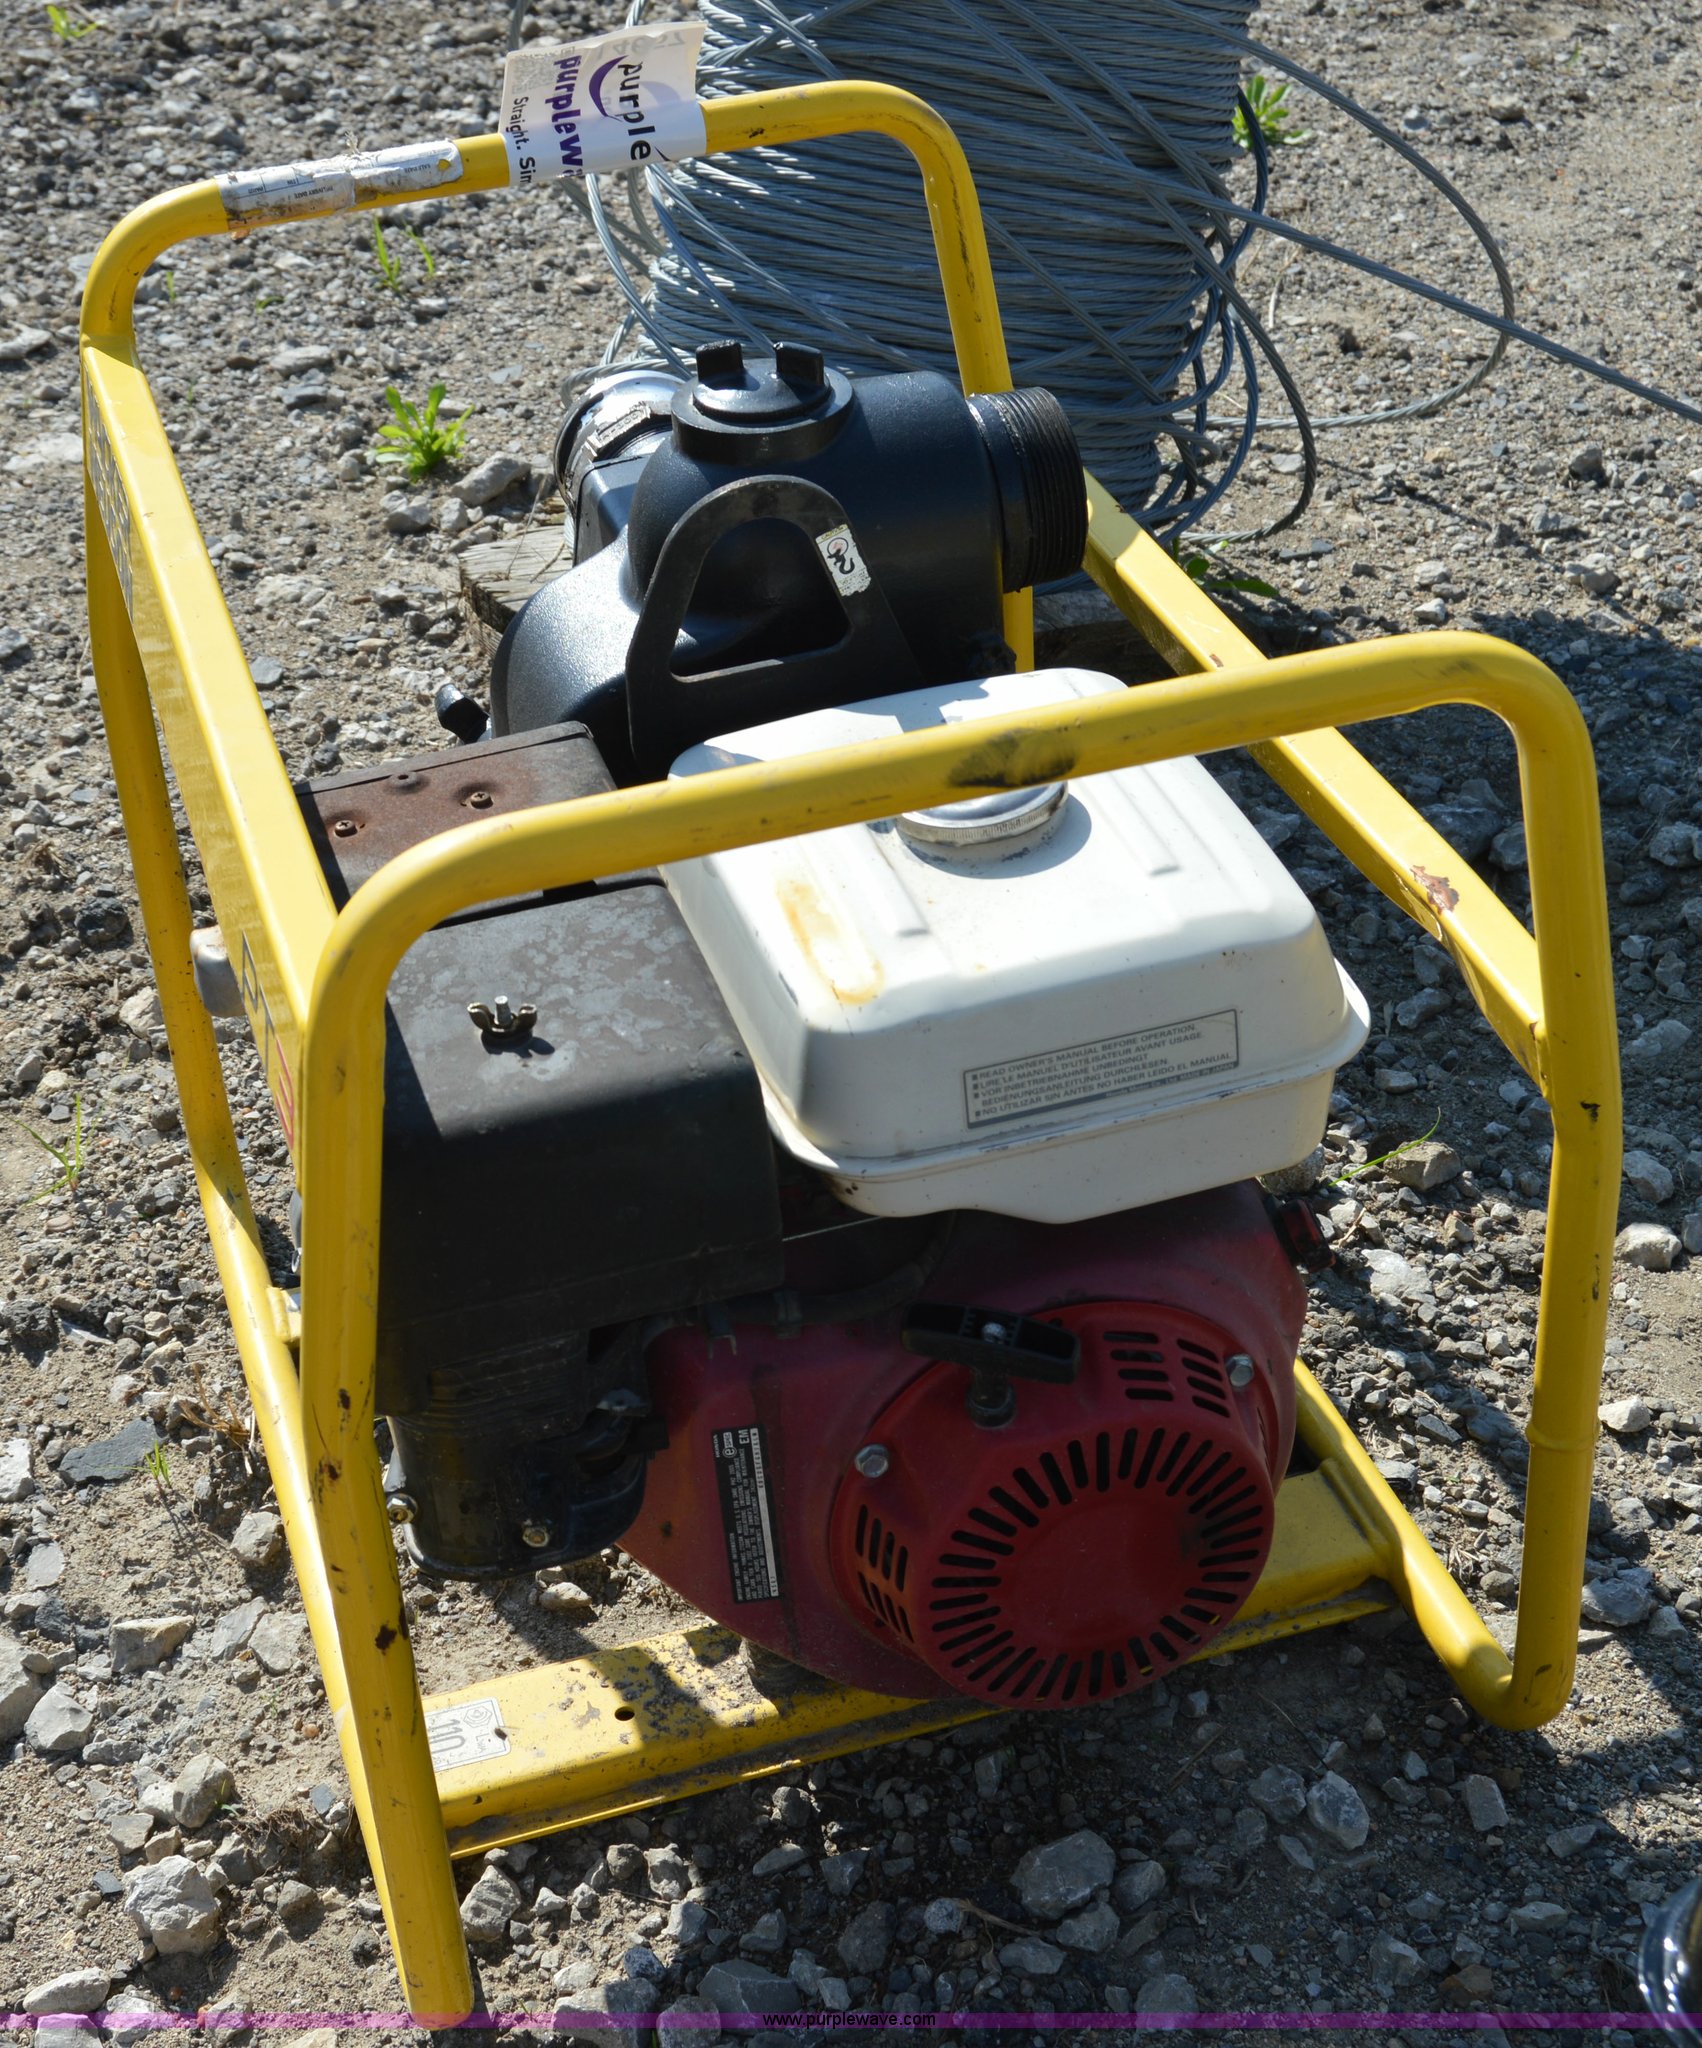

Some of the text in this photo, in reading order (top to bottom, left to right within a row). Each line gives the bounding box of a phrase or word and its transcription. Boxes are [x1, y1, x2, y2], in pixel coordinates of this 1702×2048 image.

[506, 96, 529, 150] Straight.
[615, 61, 656, 161] purple
[978, 1067, 1005, 1079] READ
[1008, 1056, 1053, 1072] OWNER'S
[1055, 1046, 1097, 1062] MANUAL
[1101, 1037, 1137, 1051] BEFORE
[980, 1086, 1001, 1097] VOR
[1091, 1053, 1148, 1072] UNBEDINGT
[1016, 1064, 1058, 1080] MANUEL
[1134, 1040, 1166, 1053] AVANT
[982, 1106, 997, 1115] NO
[999, 1096, 1041, 1111] UTILIZAR
[1044, 1091, 1060, 1101] SIN
[1063, 1083, 1094, 1097] ANTES
[1097, 1080, 1111, 1089] NO
[1113, 1072, 1145, 1085] HABER
[1147, 1065, 1174, 1078] LEIDO
[1177, 1062, 1188, 1071] EL
[737, 1428, 749, 1444] EM
